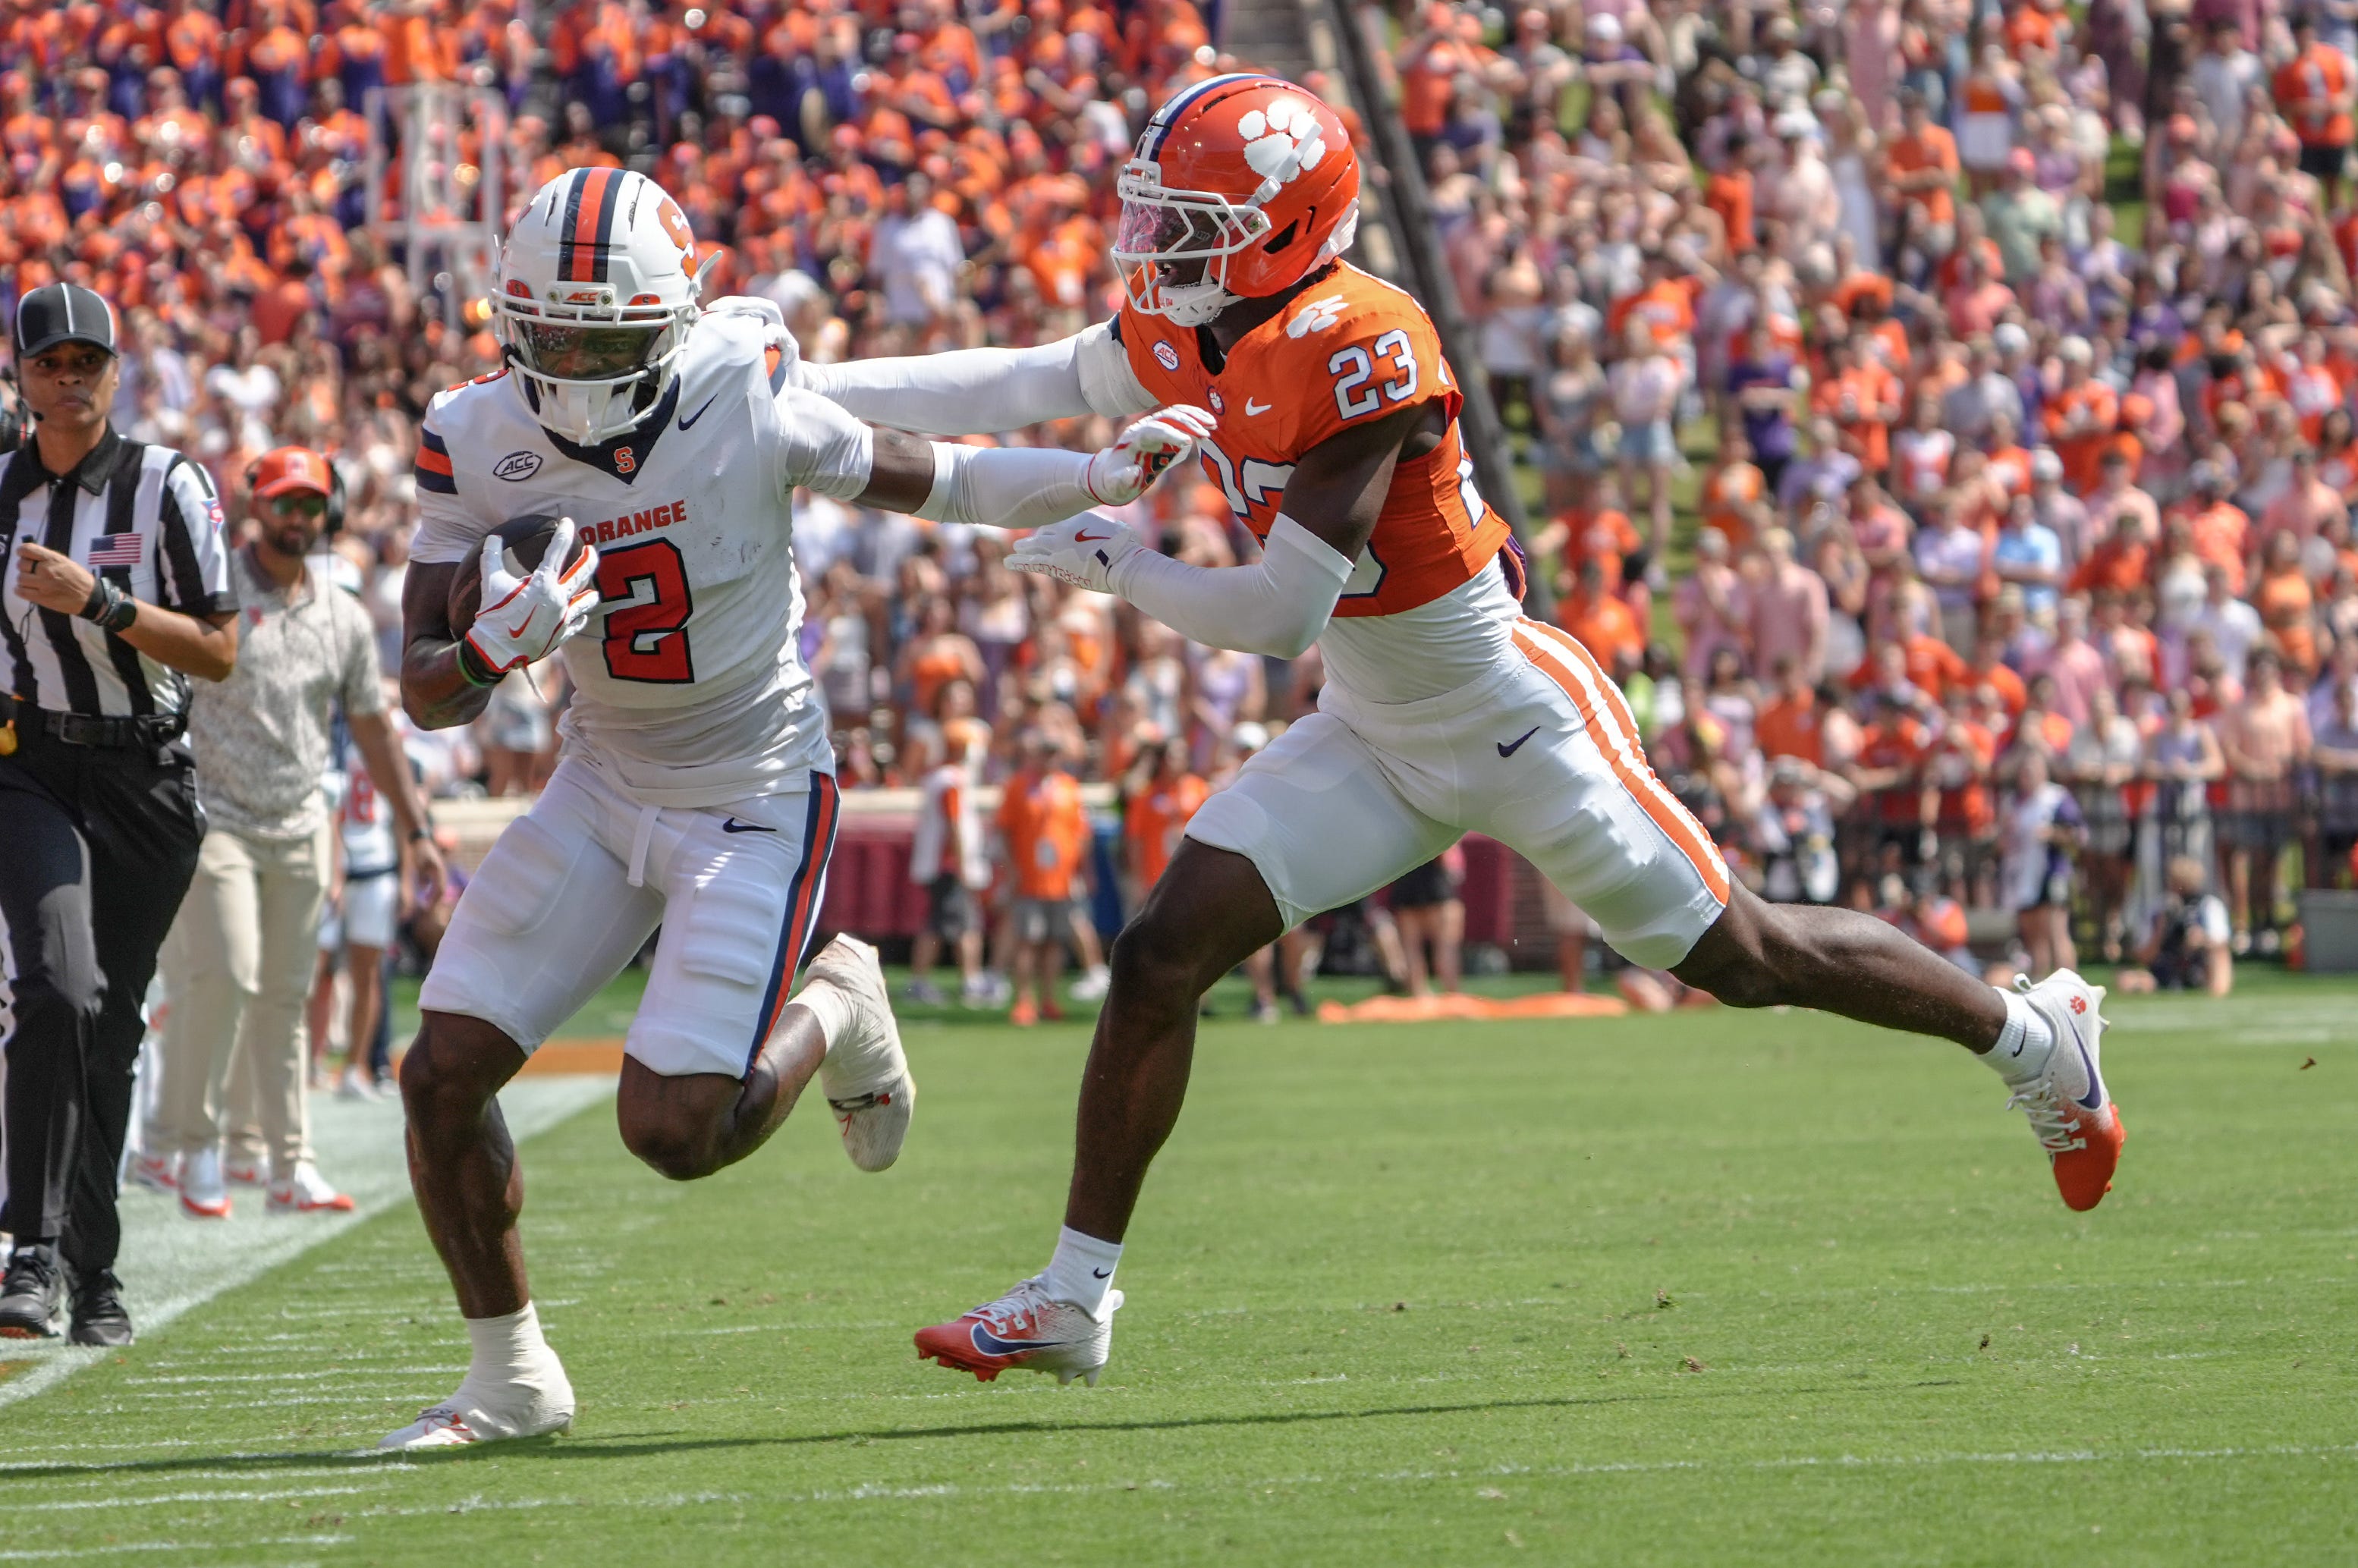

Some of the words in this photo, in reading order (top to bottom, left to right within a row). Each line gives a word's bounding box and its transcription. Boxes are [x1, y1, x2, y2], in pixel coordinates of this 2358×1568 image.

[656, 196, 698, 281] S
[566, 292, 599, 301] ACC
[1157, 347, 1176, 363] ACC
[1328, 328, 1418, 420] 23
[501, 455, 533, 473] ACC
[614, 446, 637, 473] S
[579, 500, 687, 545] ORANGE
[592, 536, 695, 683] 2
